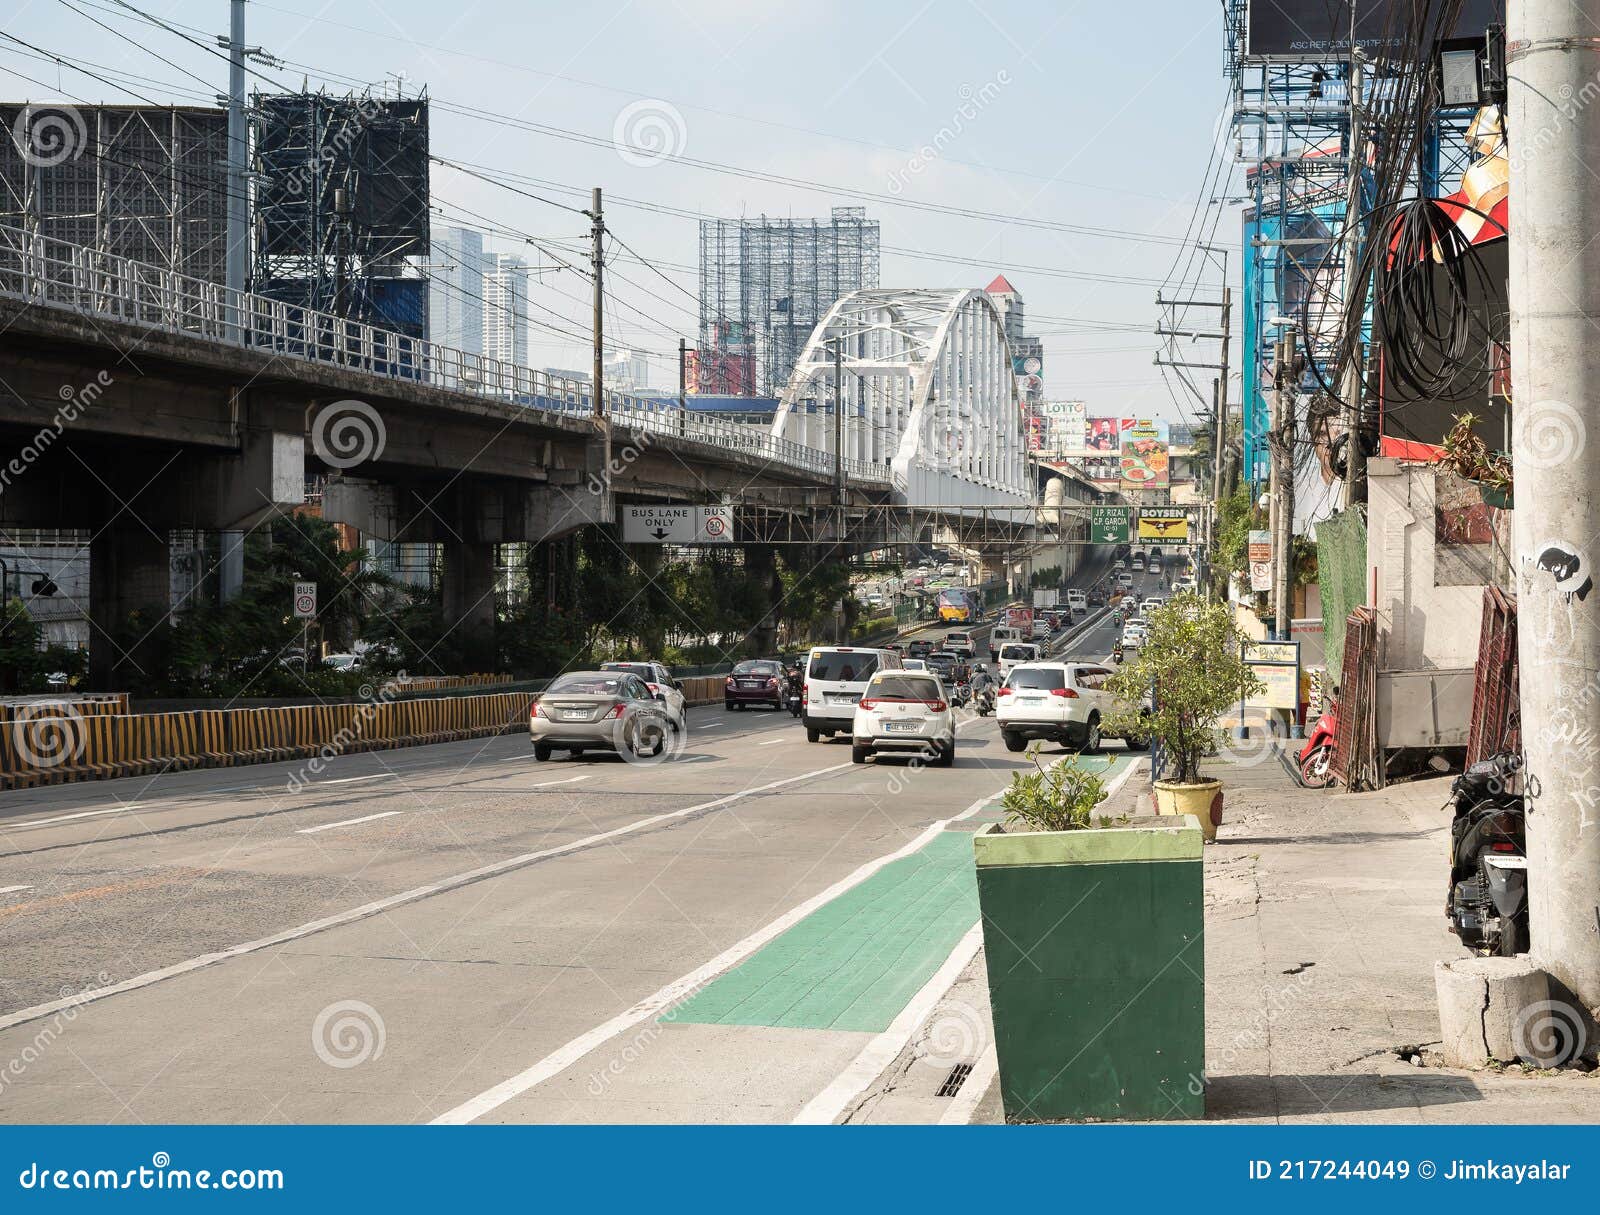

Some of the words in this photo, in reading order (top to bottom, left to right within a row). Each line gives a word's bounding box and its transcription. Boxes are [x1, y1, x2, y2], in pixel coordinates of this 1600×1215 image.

[1290, 41, 1307, 49] ASC
[1309, 40, 1327, 48] REF
[631, 509, 654, 518] BUS
[658, 509, 689, 518] LANE
[704, 507, 726, 516] BUS
[1095, 508, 1104, 517] J.P.
[1106, 508, 1125, 517] RIZAL
[1141, 508, 1184, 518] BOYSEN
[645, 518, 675, 527] ONLY
[709, 521, 720, 529] 50
[1093, 517, 1104, 526] C.P.
[1105, 517, 1127, 526] GARCIA
[297, 586, 314, 594] BUS
